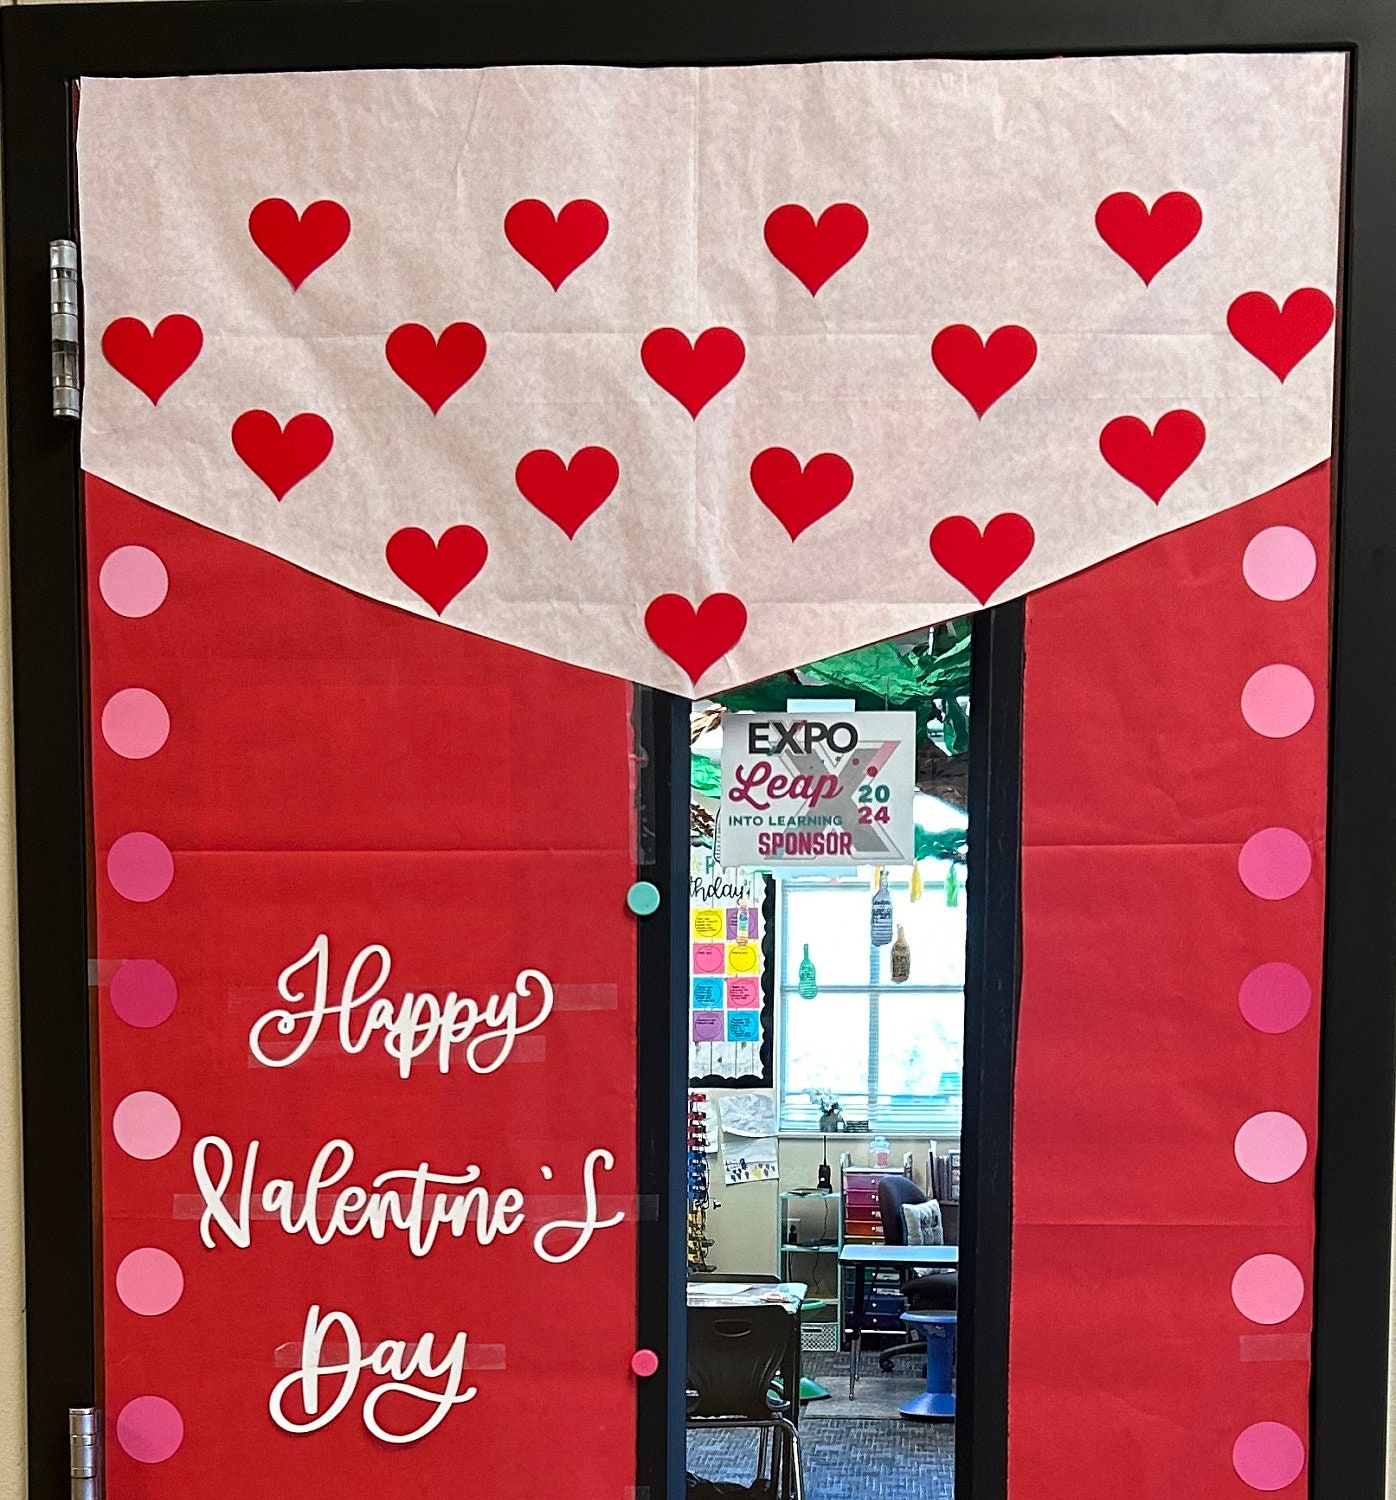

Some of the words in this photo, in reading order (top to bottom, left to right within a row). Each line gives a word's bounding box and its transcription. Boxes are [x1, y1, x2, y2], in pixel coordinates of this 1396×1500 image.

[749, 721, 858, 754] EXPO
[728, 761, 843, 811] Leap
[858, 785, 890, 803] 20
[729, 816, 763, 826] INTO
[769, 815, 843, 827] LEARNING
[858, 806, 890, 824] 24
[758, 832, 853, 855] SPONSOR
[249, 934, 554, 1079] Happy
[269, 1304, 477, 1444] Day
